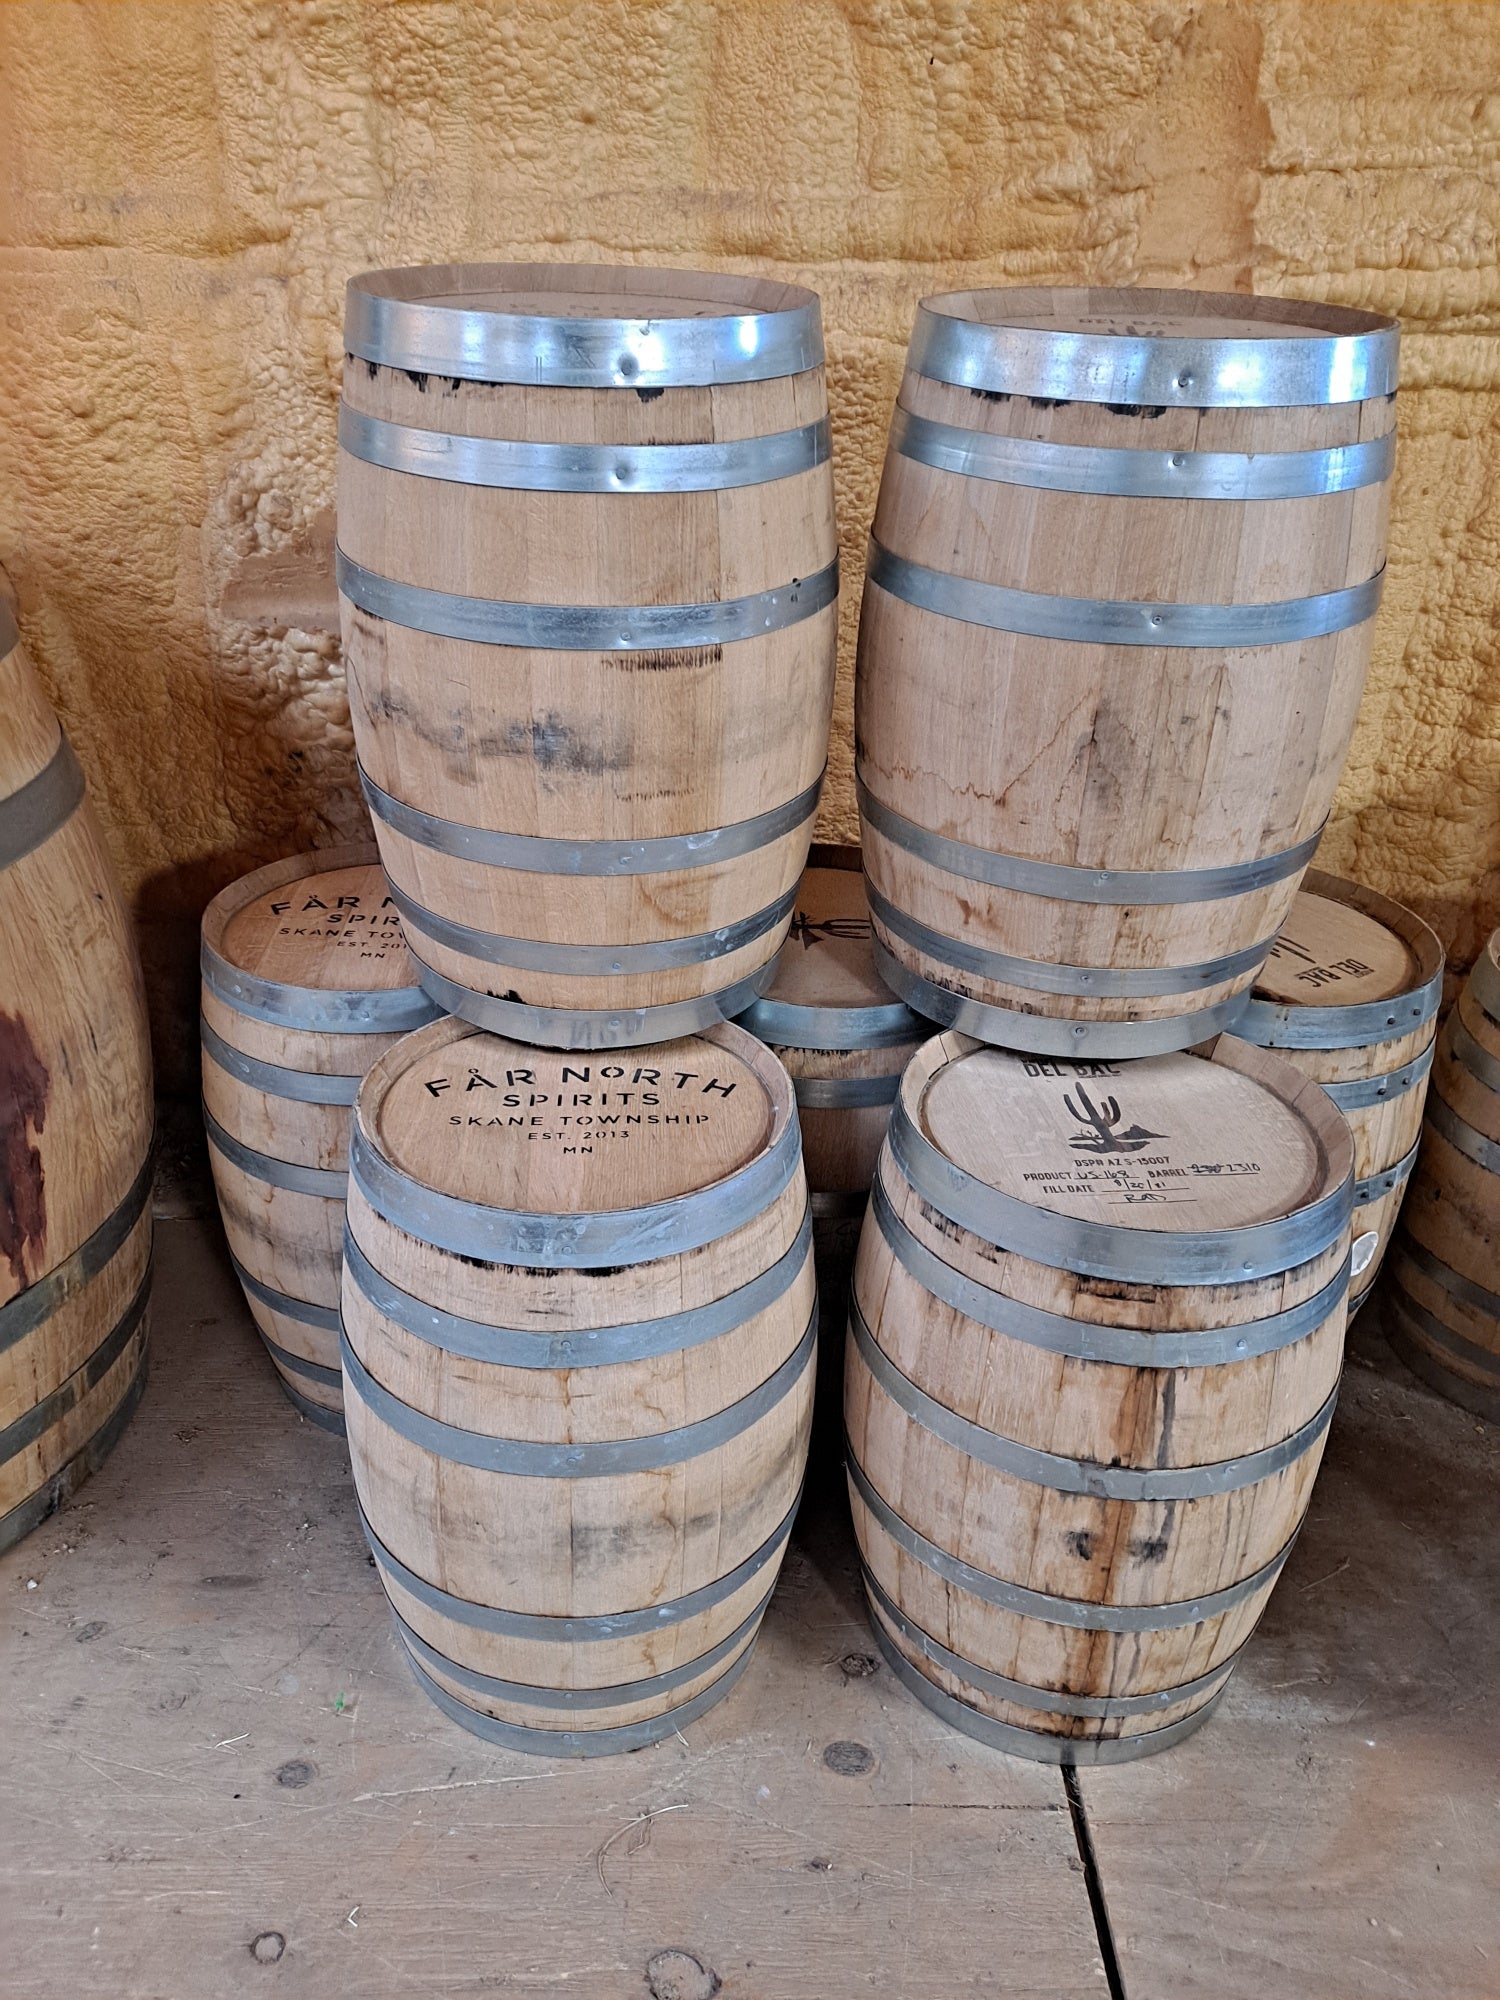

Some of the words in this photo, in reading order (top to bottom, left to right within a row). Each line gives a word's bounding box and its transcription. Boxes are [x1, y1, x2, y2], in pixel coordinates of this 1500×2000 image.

[327, 914, 400, 926] SPIR
[279, 928, 356, 938] SKANE
[1328, 958, 1368, 975] DEL
[1298, 969, 1342, 988] BAC
[1022, 1061, 1067, 1077] DEL
[424, 1068, 536, 1098] FÅR
[562, 1066, 737, 1098] NORTH
[502, 1093, 660, 1107] SPIRITS
[449, 1116, 544, 1126] SKANE
[560, 1114, 709, 1126] TOWNSHIP
[528, 1132, 571, 1140] EST.
[583, 1130, 630, 1139] 2013
[563, 1146, 593, 1154] MN
[1023, 1171, 1072, 1181] PRODUCT
[1147, 1169, 1190, 1178] BARREL
[1042, 1185, 1066, 1194] FILL
[1068, 1184, 1095, 1193] DATE
